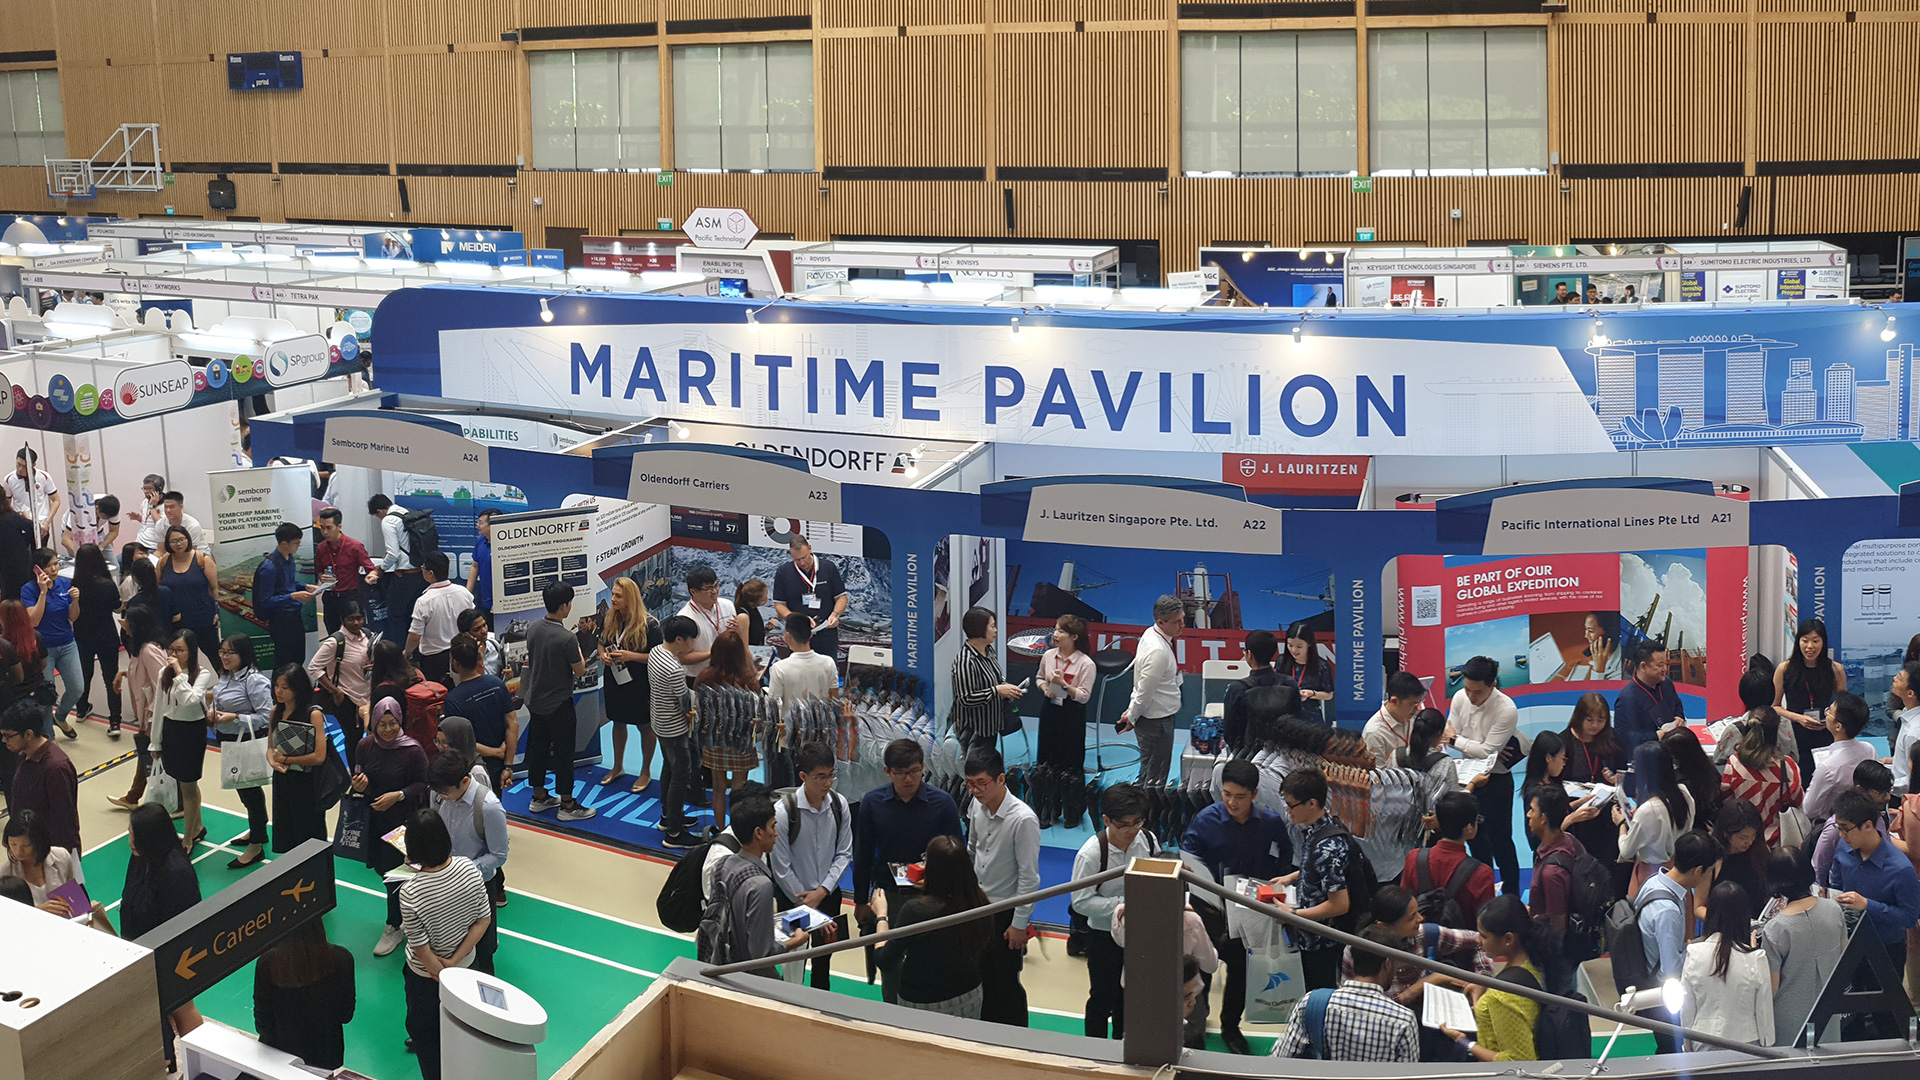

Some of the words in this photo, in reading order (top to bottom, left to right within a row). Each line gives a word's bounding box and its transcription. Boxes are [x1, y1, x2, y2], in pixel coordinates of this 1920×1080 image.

[658, 174, 672, 183] EXIT
[1353, 181, 1371, 189] EXIT
[694, 216, 722, 229] ASM
[459, 241, 496, 253] MEIDEN
[694, 234, 713, 242] Pacific
[714, 235, 746, 244] Technology
[1700, 258, 1732, 266] SUMITOMO
[1762, 257, 1798, 265] INDUSTRIES,
[154, 283, 181, 291] SKYWORKS
[290, 292, 308, 300] TETRA
[290, 350, 326, 367] SPgroup
[139, 377, 190, 399] SUNSEAP
[569, 342, 941, 421] MARITIME
[985, 365, 1405, 438] PAVILION
[463, 428, 519, 442] PABILITIES
[331, 438, 368, 451] Sembcorp
[370, 443, 394, 454] Marine
[396, 445, 409, 454] Ltd
[462, 453, 479, 463] A24
[734, 442, 887, 472] NDORFF
[1262, 463, 1273, 474] J.
[1278, 463, 1359, 475] LAURITZEN
[238, 487, 272, 496] sembcorp
[640, 473, 690, 487] Oldendorff
[693, 478, 730, 491] Carriers
[808, 490, 828, 501] A23
[238, 496, 263, 504] marine
[217, 511, 253, 519] SEMBCORP
[218, 517, 237, 526] YOUR
[238, 515, 272, 524] PLATFORM
[1039, 509, 1050, 520] J.
[1053, 510, 1106, 523] Lauritzen
[1108, 513, 1166, 528] Singapore
[1170, 516, 1192, 527] Pte.
[1196, 517, 1218, 528] Ltd.
[1243, 519, 1266, 530] A22
[1501, 519, 1541, 531] Pacific
[1544, 517, 1621, 530] International
[1624, 515, 1655, 527] Lines
[1658, 514, 1677, 526] Pte
[1680, 513, 1700, 525] Ltd
[1711, 512, 1732, 523] A21
[218, 524, 246, 532] CHANGE
[247, 522, 261, 530] THE
[497, 522, 576, 541] OLDENDORFF
[498, 543, 530, 551] OLDENDORFF
[552, 537, 583, 545] PROGRAMME
[600, 545, 621, 562] STEADY
[621, 534, 644, 552] GROWTH
[1862, 542, 1907, 550] multipurpose
[907, 553, 918, 609] PAVILION
[1456, 576, 1471, 587] BE
[1473, 570, 1502, 585] PART
[1504, 567, 1522, 579] OF
[1524, 565, 1553, 578] OUR
[1456, 586, 1505, 600] GLOBAL
[1507, 577, 1580, 593] EXPEDITION
[1814, 566, 1826, 624] PAVILION
[1352, 579, 1364, 637] PAVILION
[1397, 587, 1409, 672] www.pilship
[1739, 575, 1748, 675] www.pilship.c
[907, 611, 918, 669] MARITIME
[1353, 641, 1365, 701] MARITIME
[212, 907, 274, 956] Career
